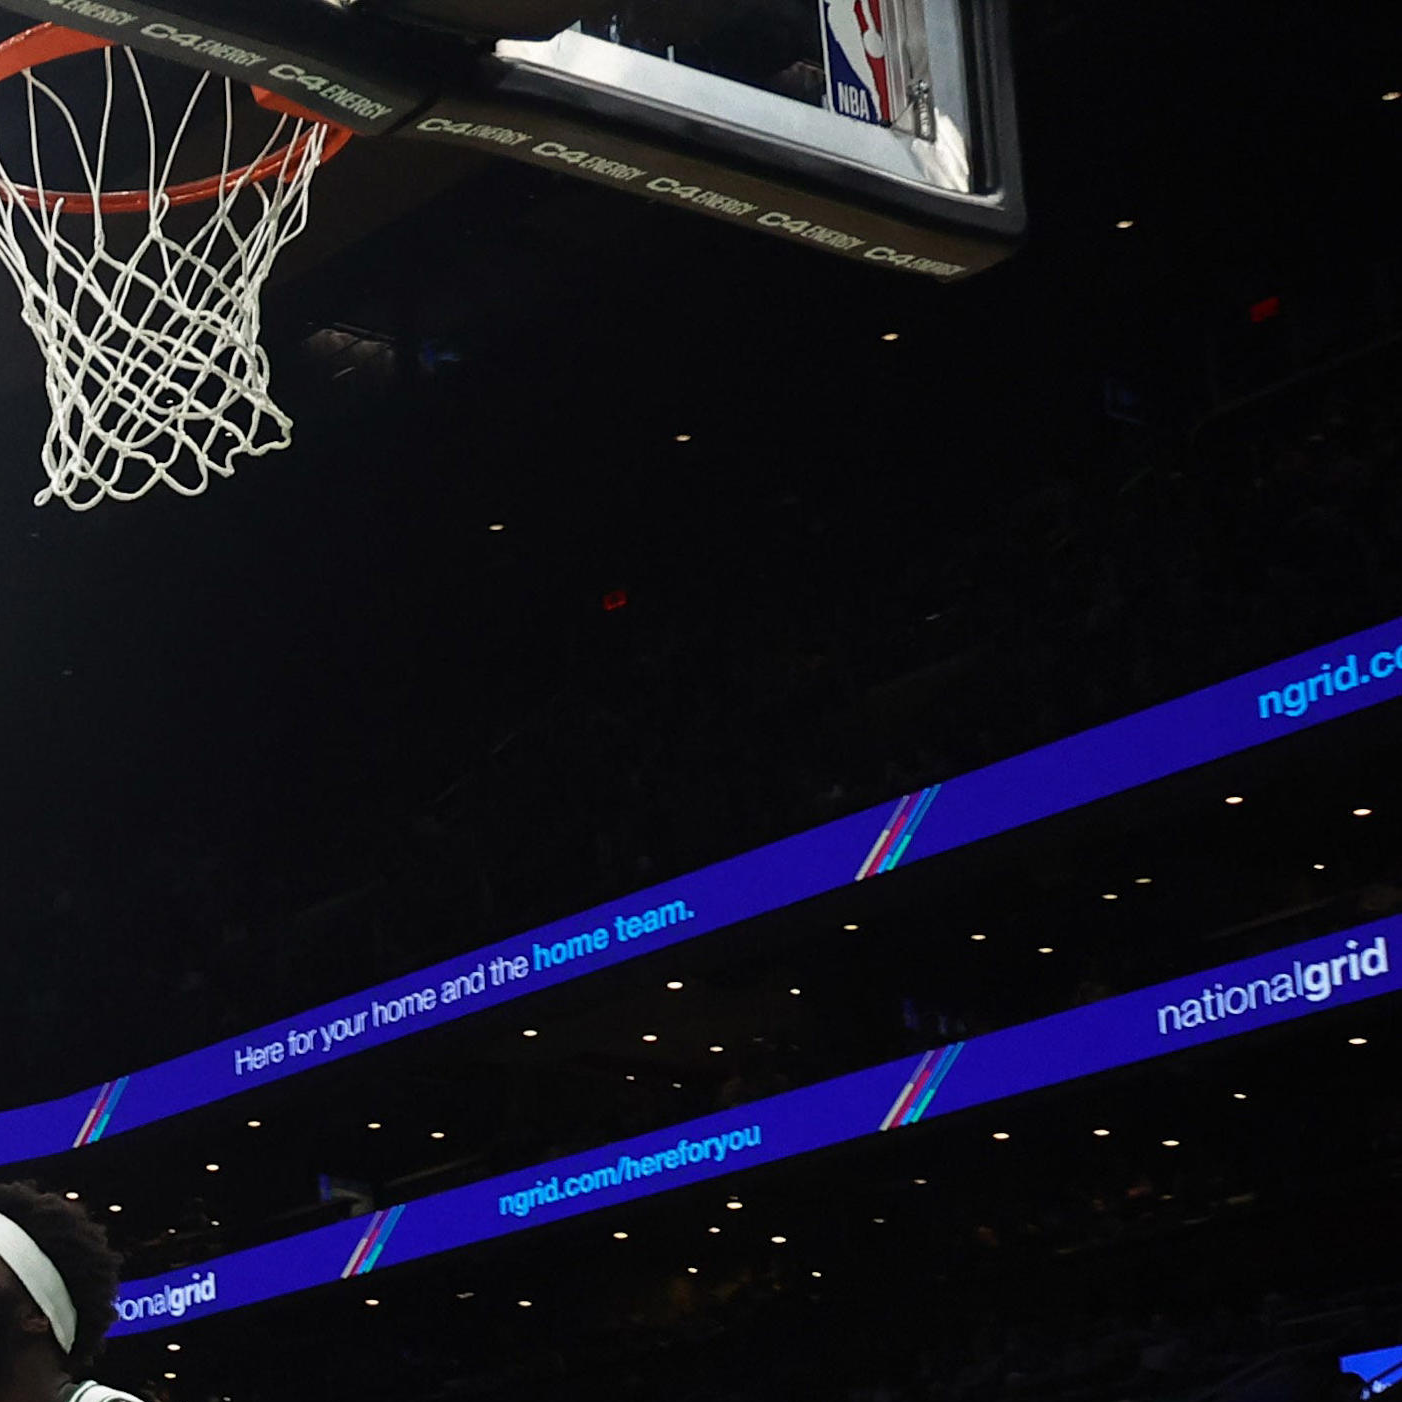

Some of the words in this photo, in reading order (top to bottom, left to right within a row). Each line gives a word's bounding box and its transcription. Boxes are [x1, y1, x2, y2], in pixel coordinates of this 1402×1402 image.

[141, 23, 201, 49] C4
[194, 39, 267, 69] ENERGY
[268, 63, 329, 92] C4
[320, 83, 393, 121] ENERGY
[837, 81, 870, 121] NBA
[416, 118, 473, 135] C4
[465, 124, 533, 146] ENERGY
[532, 141, 590, 163] C4
[580, 156, 647, 181] ENERGY
[646, 177, 702, 198] C4
[692, 190, 758, 216] ENERGY
[756, 212, 811, 233] C4
[801, 225, 866, 250] ENERGY
[863, 247, 915, 266] C4
[1258, 645, 1402, 719] ngrid.c
[234, 1041, 285, 1075] Here
[287, 1029, 317, 1057] for
[320, 1011, 369, 1052] your
[371, 988, 437, 1027] home
[440, 963, 486, 1004] and
[489, 955, 529, 986] the
[532, 927, 609, 971] home
[614, 900, 695, 942] team.
[1157, 936, 1389, 1035] nationalgrid
[499, 1125, 762, 1217] ngrid.com/hereforyou
